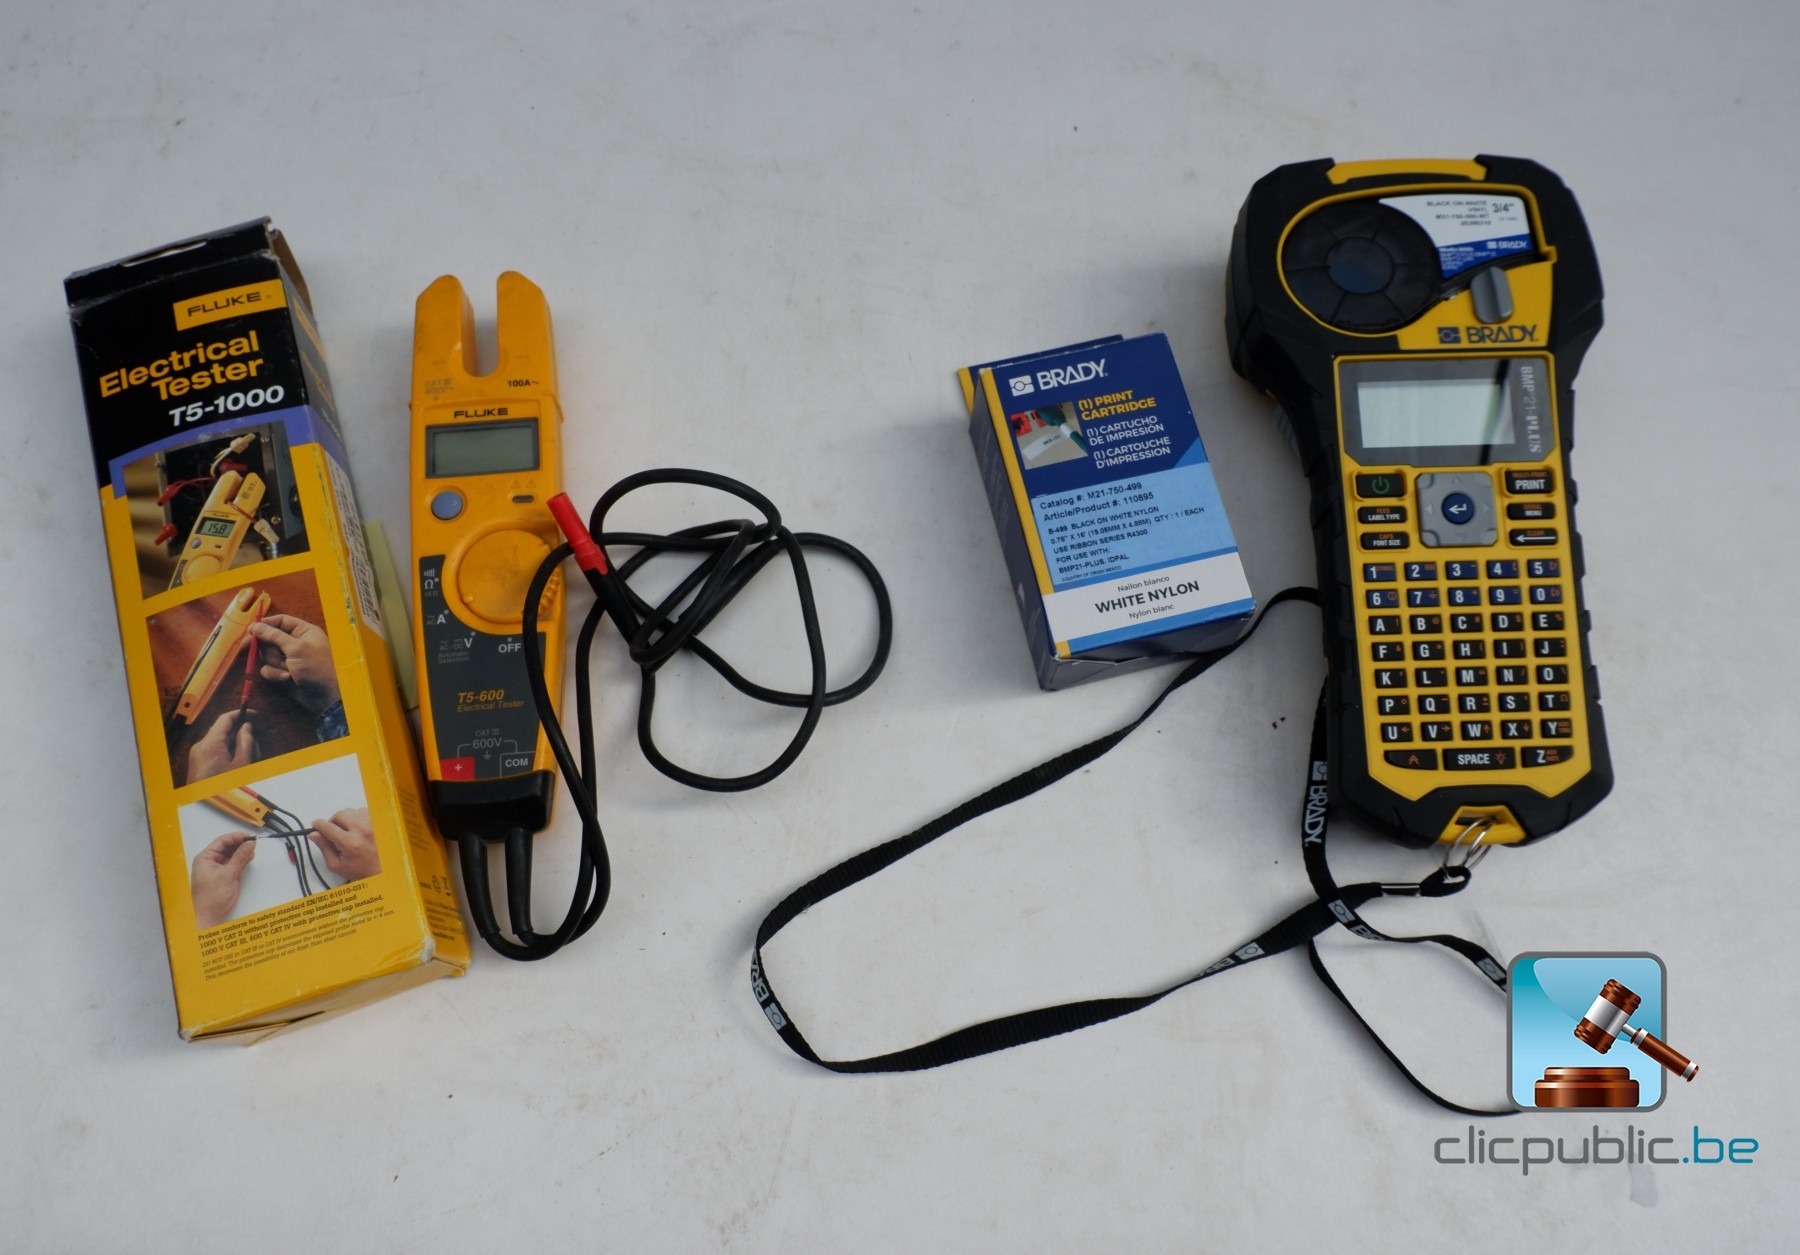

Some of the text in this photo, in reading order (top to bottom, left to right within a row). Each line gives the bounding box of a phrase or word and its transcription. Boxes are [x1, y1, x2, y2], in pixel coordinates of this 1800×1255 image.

[1498, 240, 1528, 249] BRADY
[187, 292, 262, 317] FLUKE
[1466, 324, 1538, 344] BRADY
[99, 330, 260, 398] Electrical
[151, 358, 264, 401] Tester
[1036, 358, 1106, 391] BRADY
[168, 385, 285, 427] T5-1000
[1078, 390, 1134, 411] (1) PRINT
[1080, 398, 1157, 421] CARTRIDGE
[454, 407, 509, 418] FLUKE
[1086, 415, 1158, 438] (1) CARTUCHO
[1089, 423, 1164, 447] DE IMPRESIÓN
[1094, 436, 1171, 461] (1) CARTOUCHE
[1096, 446, 1171, 470] D'IMPRESSION
[1514, 479, 1546, 490] PRINT
[1040, 482, 1142, 510] Catalog #: M21-750-499
[1044, 501, 1110, 522] Article/Product
[1124, 492, 1154, 504] 110895
[1048, 506, 1159, 534] B-499 BLACK ON WHITE NYLON
[1088, 524, 1120, 538] (19.05MM
[1154, 513, 1169, 523] QTY
[1184, 506, 1204, 516] EACH
[1054, 528, 1148, 554] USE RIBBON SERIES R4300
[1056, 547, 1111, 564] FOR USE WITH:
[1108, 554, 1130, 563] IDPAL
[1369, 566, 1377, 579] 1
[1411, 564, 1420, 578] 2
[1452, 563, 1462, 576] 3
[1493, 562, 1503, 575] 4
[1534, 562, 1544, 575] 5
[1117, 576, 1170, 592] Nailon blanco
[1094, 580, 1200, 614] WHITE NYLON
[1372, 588, 1546, 606] 6 7 8 9 0
[436, 614, 446, 625] A
[1128, 604, 1174, 620] Nylon blanc
[1376, 614, 1548, 632] A B C D E
[464, 638, 473, 648] V
[498, 642, 522, 654] OFF
[1378, 641, 1550, 658] F G H I J
[1382, 667, 1554, 685] K L M N O
[456, 700, 525, 712] Electrical Tester
[458, 689, 504, 704] T5-600
[1384, 694, 1555, 712] P Q R S T
[1388, 726, 1398, 740] U
[1428, 725, 1438, 738] V
[1467, 724, 1482, 738] W
[1508, 722, 1518, 736] X
[1547, 722, 1558, 735] Y
[472, 737, 502, 750] 600V
[505, 758, 528, 768] COM
[1458, 753, 1490, 765] SPACE
[1536, 750, 1546, 764] Z
[1304, 785, 1328, 844] BRADY
[198, 931, 220, 941] Probes
[221, 922, 248, 934] conform
[256, 912, 276, 922] safety
[277, 901, 304, 916] standard
[330, 883, 368, 899] 61010-031:
[200, 940, 216, 949] 1000
[224, 932, 237, 942] CAT
[244, 922, 268, 934] without
[270, 912, 302, 928] protective
[303, 908, 314, 916] cap
[316, 898, 344, 912] installed
[344, 894, 357, 902] and
[202, 948, 218, 957] 1000
[225, 940, 238, 949] CAT
[270, 926, 283, 934] CAT
[292, 918, 308, 928] with
[308, 909, 340, 923] protective
[342, 904, 354, 912] cap
[354, 894, 384, 908] installed.
